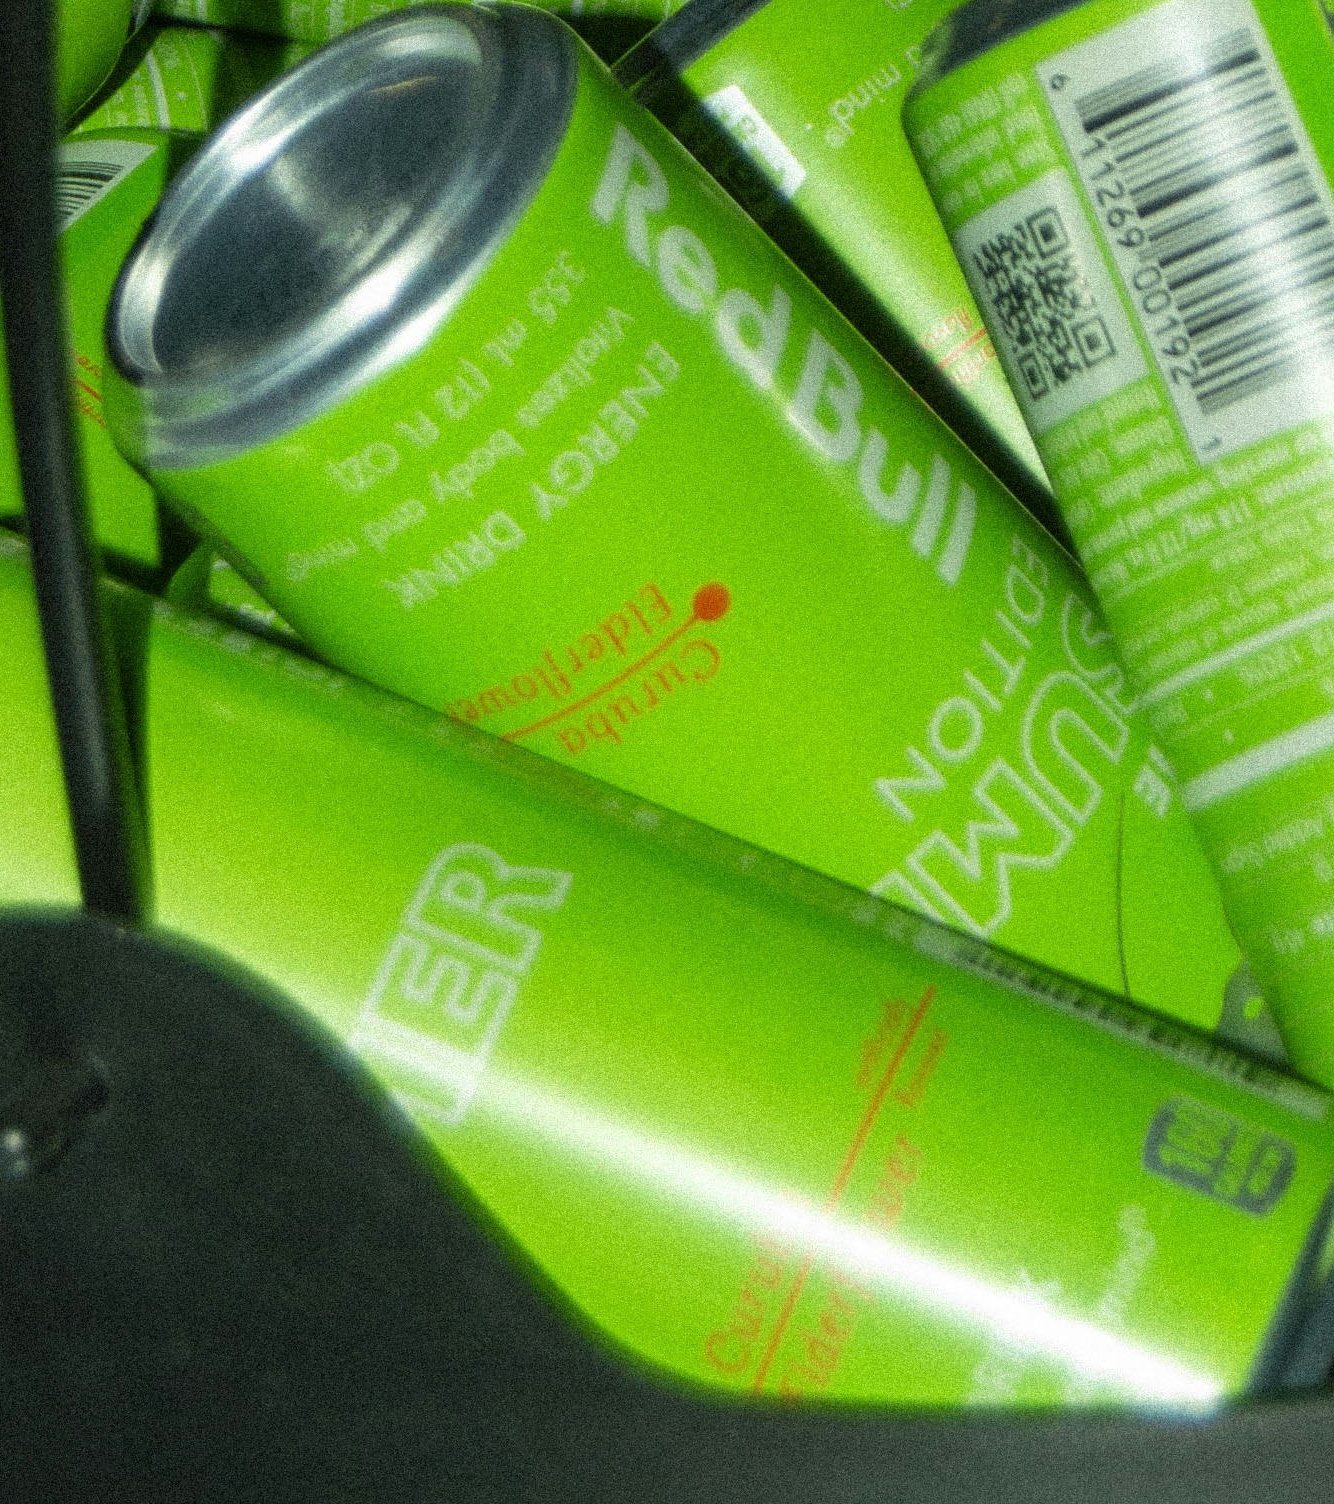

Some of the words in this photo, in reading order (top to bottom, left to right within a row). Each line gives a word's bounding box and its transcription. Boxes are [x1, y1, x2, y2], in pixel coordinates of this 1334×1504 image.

[1046, 68, 1072, 95] 6
[1076, 131, 1146, 254] 11269
[1126, 258, 1198, 388] 00192
[1198, 433, 1223, 455] 1
[423, 420, 526, 513] body
[521, 338, 684, 517] ENERGY
[360, 491, 432, 554] and
[380, 506, 524, 613] DRINK
[553, 630, 726, 769] Curuba
